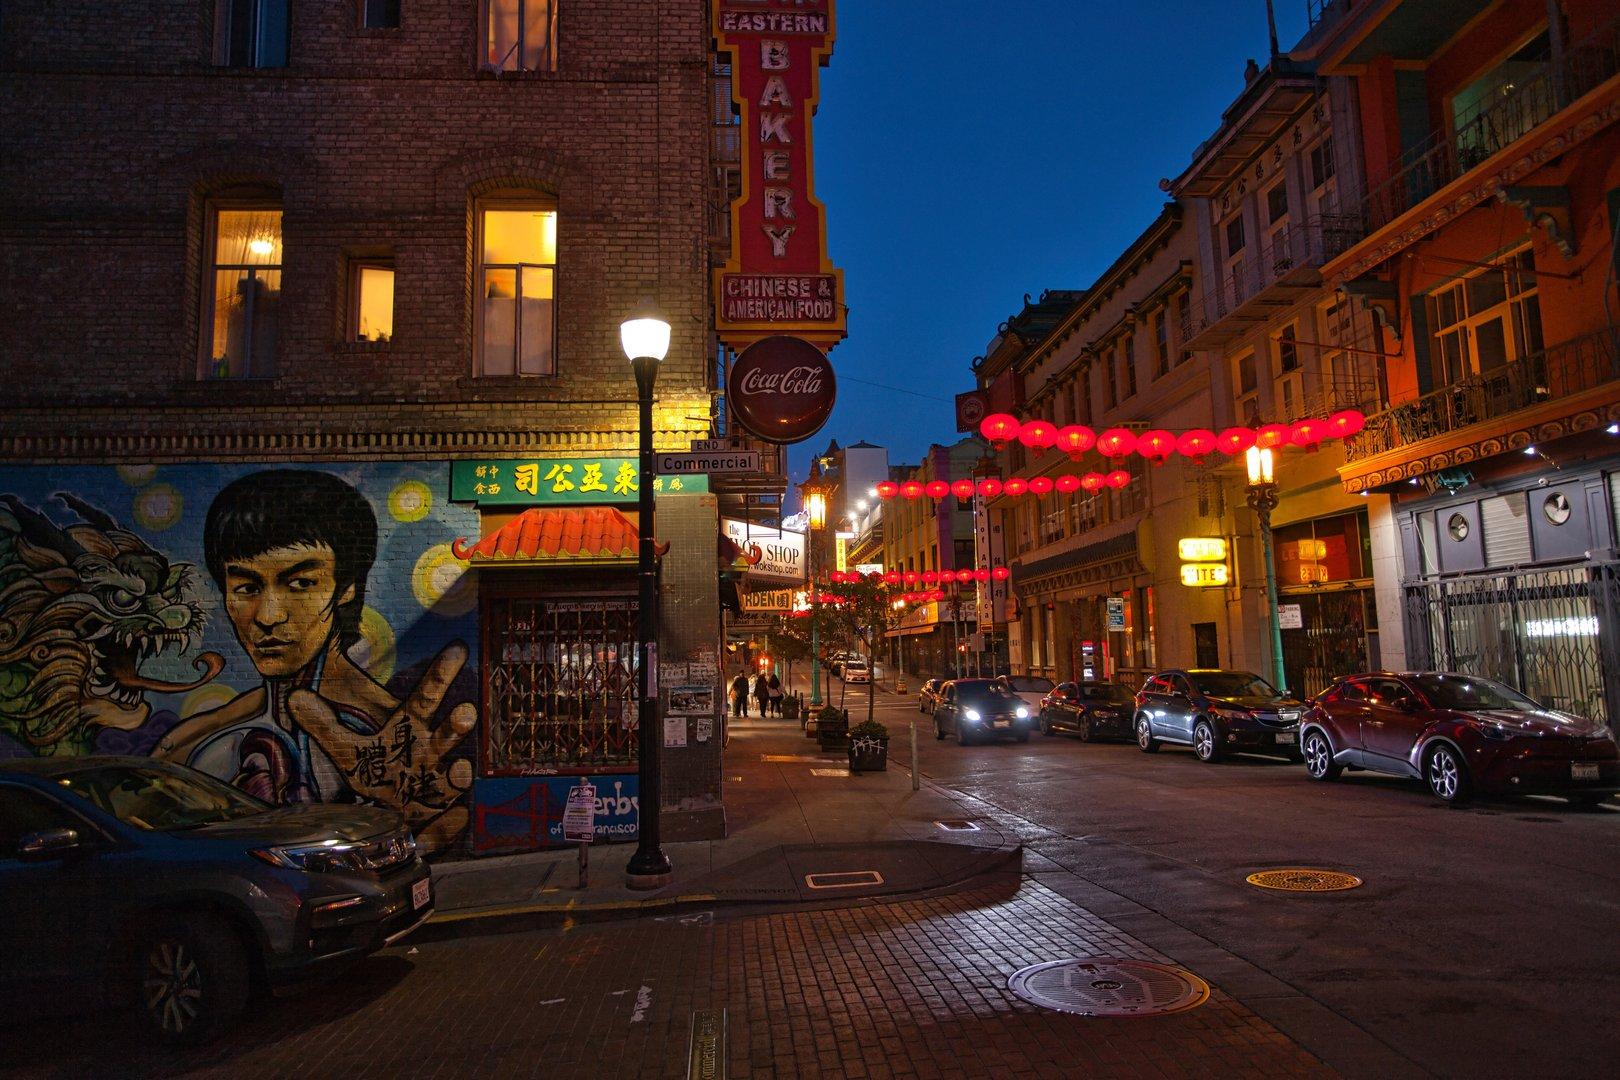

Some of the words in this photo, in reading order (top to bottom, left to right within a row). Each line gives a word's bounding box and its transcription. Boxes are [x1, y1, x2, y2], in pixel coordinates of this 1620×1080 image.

[723, 12, 825, 32] EASTERN
[760, 39, 797, 258] BAKERY
[727, 278, 811, 298] CHINESE
[818, 278, 832, 298] &
[728, 299, 795, 319] AMERICAN
[797, 299, 833, 319] FOOD
[741, 366, 824, 395] Coca-Cola
[696, 441, 719, 450] END
[664, 456, 751, 470] Commercial
[766, 543, 799, 565] SHOP
[1186, 568, 1223, 581] ITE
[981, 554, 990, 619] Amrica
[551, 822, 564, 834] of
[593, 823, 637, 835] rancisco
